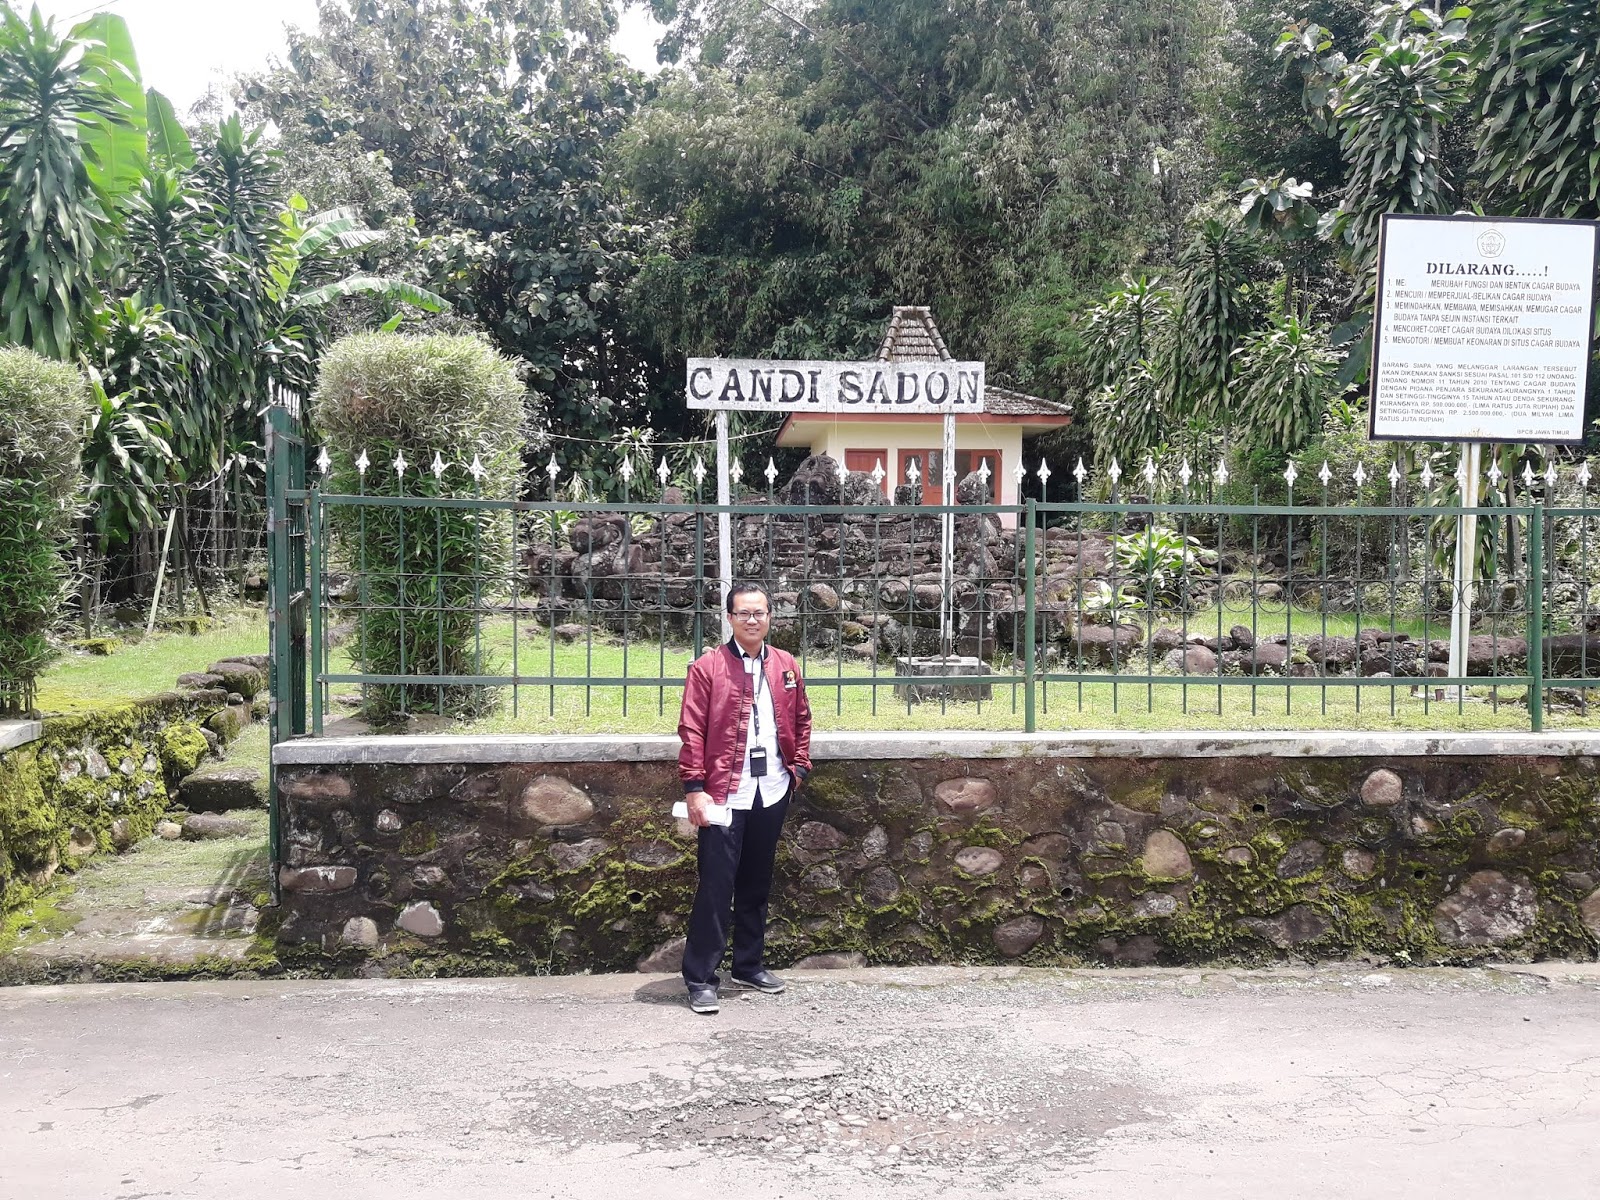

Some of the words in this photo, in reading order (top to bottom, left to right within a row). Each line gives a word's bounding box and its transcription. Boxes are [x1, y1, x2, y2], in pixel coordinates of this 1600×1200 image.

[1431, 280, 1463, 288] MERUBAH
[1465, 280, 1488, 288] FUNGSI
[1532, 282, 1554, 290] CAGAR
[1556, 283, 1580, 291] BUDAYA
[1387, 290, 1392, 298] 2.
[1395, 290, 1424, 298] MENCURI
[1502, 293, 1525, 301] CAGAR
[1526, 305, 1558, 313] MEMUGAR
[1394, 313, 1418, 321] BUDAYA
[1420, 314, 1440, 322] TANPA
[1462, 315, 1490, 323] INSTANSI
[1493, 316, 1519, 324] TERKAIT
[1452, 326, 1475, 334] CAGAR
[1476, 327, 1501, 335] BUDAYA
[1533, 328, 1552, 336] SITUS
[1384, 336, 1389, 344] 5.
[1393, 336, 1430, 344] MENGOTORI
[1434, 337, 1465, 345] MEMBUAT
[1511, 339, 1529, 347] SITUS
[1531, 340, 1553, 348] CAGAR
[1555, 340, 1580, 348] BUDAYA
[689, 367, 821, 403] CANDI
[837, 370, 980, 405] SADON
